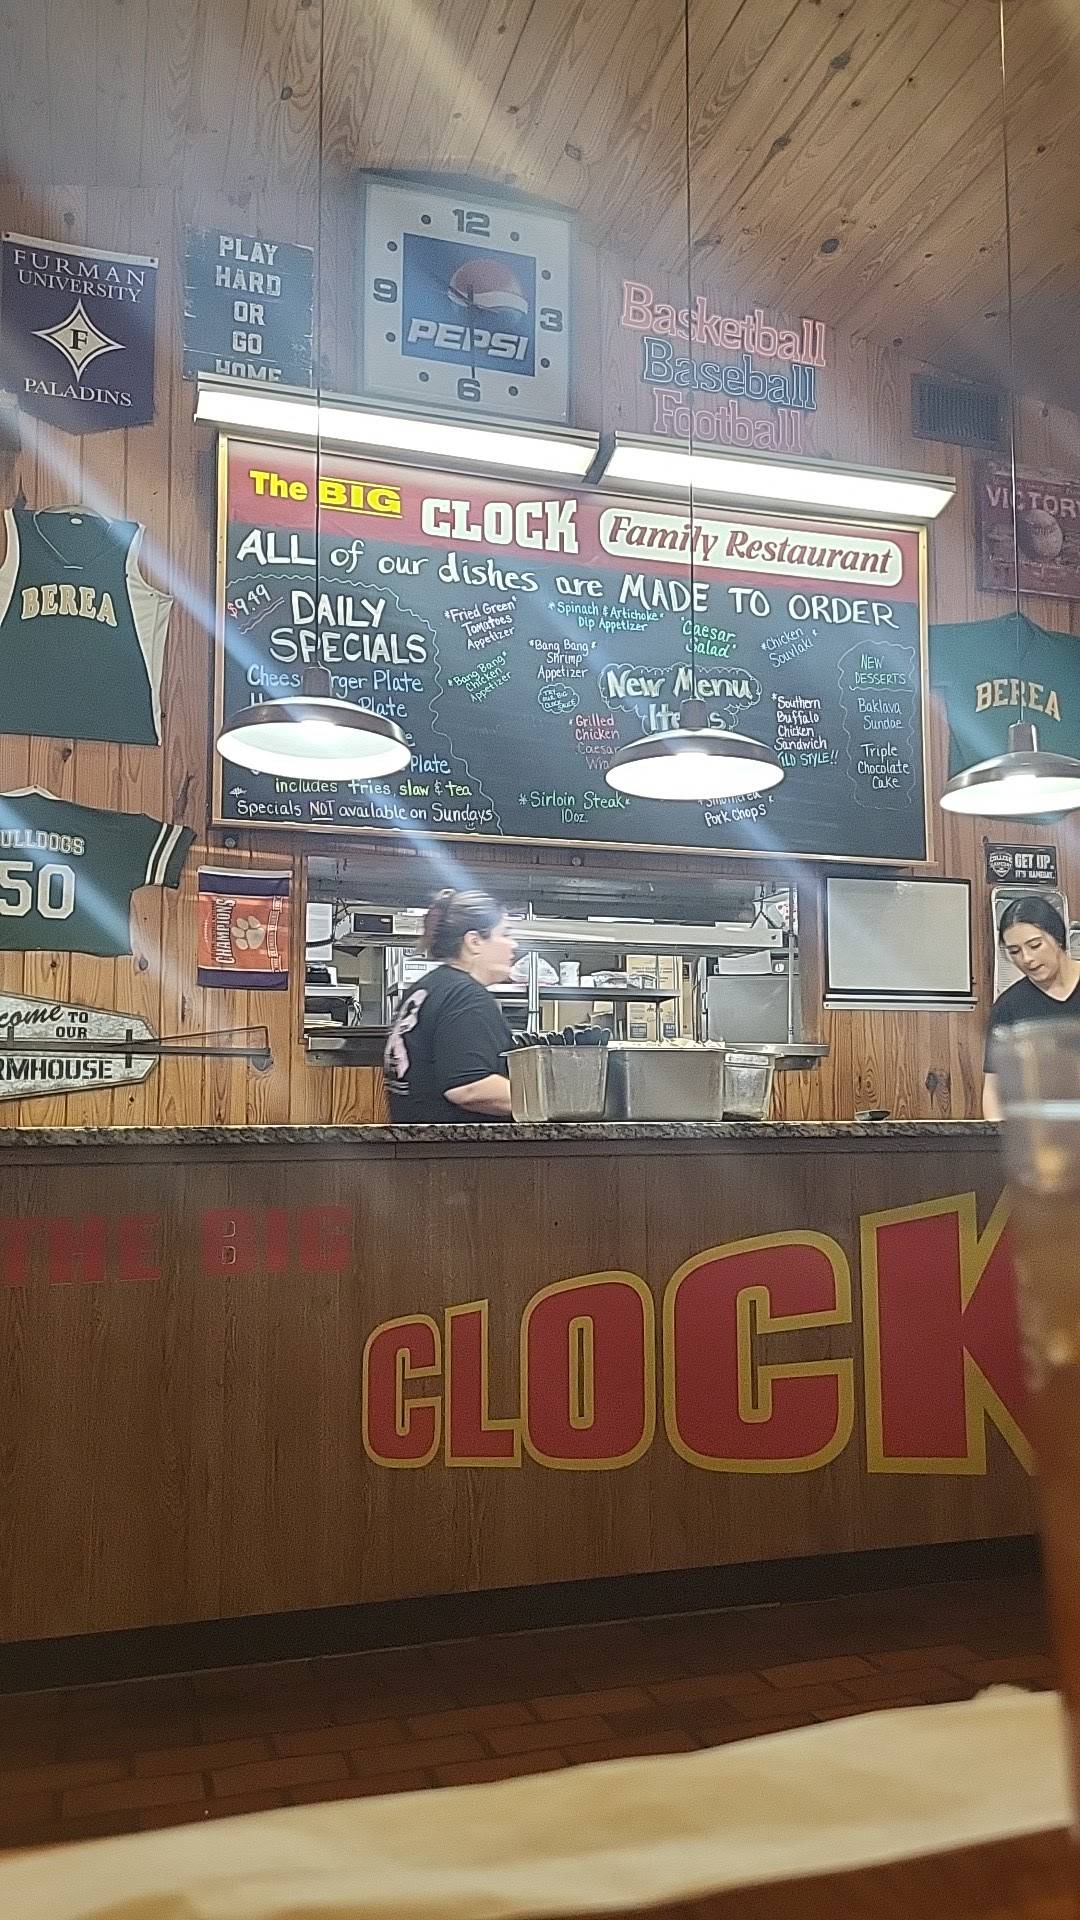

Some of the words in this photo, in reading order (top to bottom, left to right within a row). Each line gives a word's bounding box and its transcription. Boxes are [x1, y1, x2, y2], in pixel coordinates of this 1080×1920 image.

[453, 208, 490, 238] 12
[218, 234, 280, 267] PLAY
[14, 249, 145, 287] FURMAN
[19, 269, 142, 303] UNIVERSITY
[215, 264, 282, 298] HARD
[373, 277, 398, 304] 9
[233, 301, 266, 327] OR
[540, 306, 563, 334] 3
[621, 279, 827, 368] Basketball
[69, 328, 89, 351] F
[232, 331, 263, 356] GO
[407, 317, 530, 362] PEPSI
[642, 335, 817, 411] Baseball
[24, 377, 132, 407] PALADINS
[457, 377, 481, 403] 6
[653, 386, 806, 452] Football
[250, 469, 309, 501] The
[318, 480, 402, 515] BIG
[420, 497, 580, 555] CLOCK
[609, 515, 718, 562] Family
[725, 530, 894, 574] Restaurant
[236, 528, 318, 566] ALL
[330, 539, 365, 573] of
[378, 555, 429, 575] our
[438, 552, 539, 592] dishes
[556, 575, 604, 597] are
[619, 573, 710, 612] MADE
[728, 587, 771, 617] TO
[788, 594, 899, 629] ORDER
[21, 584, 118, 627] BEREA
[227, 584, 271, 619] $9.49
[291, 590, 386, 628] DAILY
[450, 603, 481, 622] Fried
[557, 601, 599, 616] Spinach
[461, 614, 513, 636] Tomatoes
[578, 616, 595, 632] Dip
[599, 618, 648, 634] Appetizer
[682, 619, 736, 643] Caesar
[270, 627, 428, 664] SPECIALS
[467, 627, 515, 650] Appetizer
[767, 627, 803, 651] Chicken
[546, 652, 582, 665] Shrimp
[769, 638, 814, 669] Souvlaki
[861, 653, 883, 669] NEW
[247, 664, 368, 699] Cheesrger
[373, 669, 423, 693] Plate
[465, 667, 503, 692] Chicken
[471, 671, 511, 702] Appetizer
[537, 666, 588, 683] Appetizer
[607, 669, 665, 698] New
[673, 666, 753, 701] Menu
[855, 672, 906, 685] DESSERTS
[358, 697, 408, 718] Plate
[778, 695, 821, 709] Southern
[859, 698, 902, 714] Baklava
[975, 678, 1062, 722] BEREA
[575, 712, 614, 727] Grilled
[650, 704, 727, 731] Ites
[777, 710, 819, 725] Buffalo
[863, 715, 903, 730] Sundae
[575, 727, 620, 741] Chicken
[774, 735, 828, 751] Sandwich
[778, 725, 814, 738] Chicken
[578, 741, 620, 755] Caesar
[861, 742, 898, 760] Triple
[410, 754, 451, 774] Plate
[585, 756, 609, 771] Wra
[857, 760, 910, 776] Chocolate
[275, 777, 338, 794] includes
[399, 780, 430, 797] slaw
[434, 780, 444, 796] &
[445, 782, 472, 797] tea
[872, 776, 901, 790] Cake
[237, 799, 301, 818] Specials
[309, 800, 334, 816] NOT
[339, 802, 407, 820] available
[410, 808, 427, 821] on
[432, 803, 493, 824] Sundays
[531, 791, 576, 808] Sirloin
[583, 791, 624, 810] Steak
[704, 810, 732, 827] Pork
[732, 803, 766, 822] Chops
[1014, 853, 1034, 869] GET
[1036, 854, 1054, 870] UP.
[0, 860, 76, 919] 50
[215, 899, 237, 964] CHAMPIONS
[67, 1011, 89, 1024] TO
[56, 1026, 88, 1039] OUR
[0, 1212, 162, 1288] THE
[201, 1205, 354, 1277] BIG
[361, 1184, 1037, 1476] CLOCK
